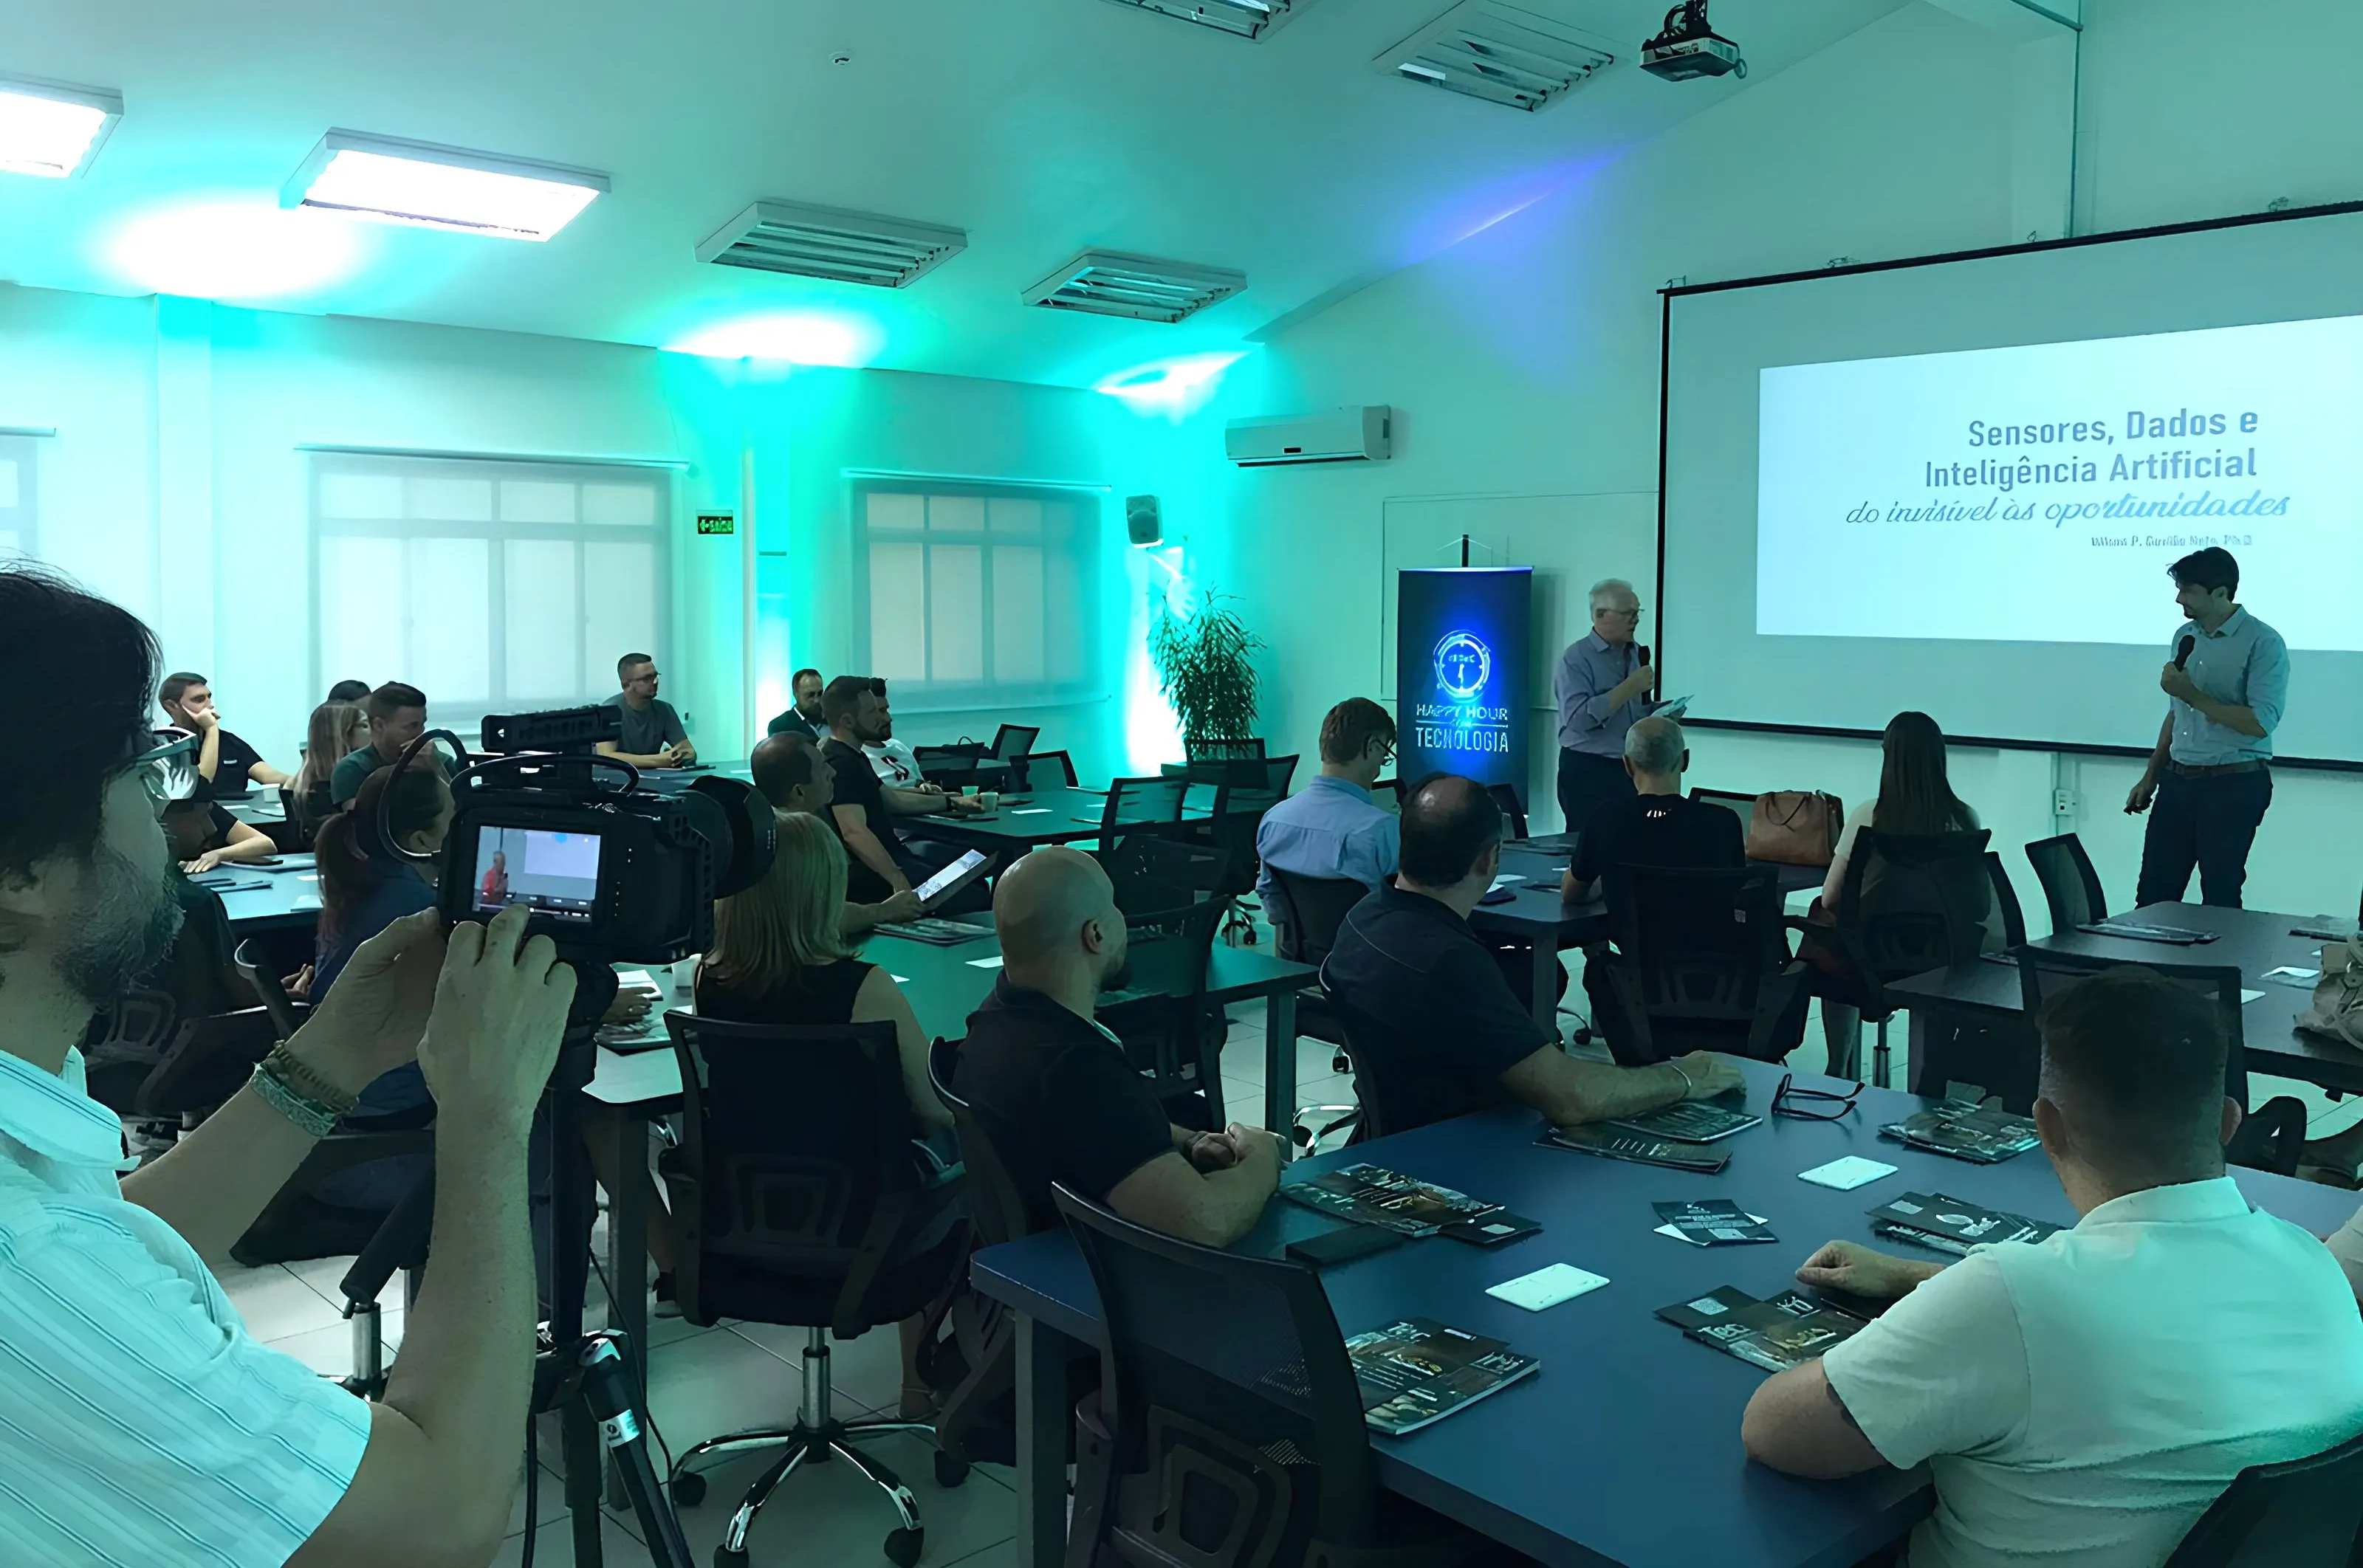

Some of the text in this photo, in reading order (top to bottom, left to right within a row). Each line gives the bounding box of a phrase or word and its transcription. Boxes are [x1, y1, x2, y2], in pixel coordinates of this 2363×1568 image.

[1969, 408, 2258, 447] Sensores, Dados e
[1926, 447, 2257, 492] Inteligência Artificial
[1846, 489, 2290, 528] do invisível às oportunidades
[1466, 705, 1508, 721] HOUR
[1416, 727, 1509, 752] TECNOLOGIA
